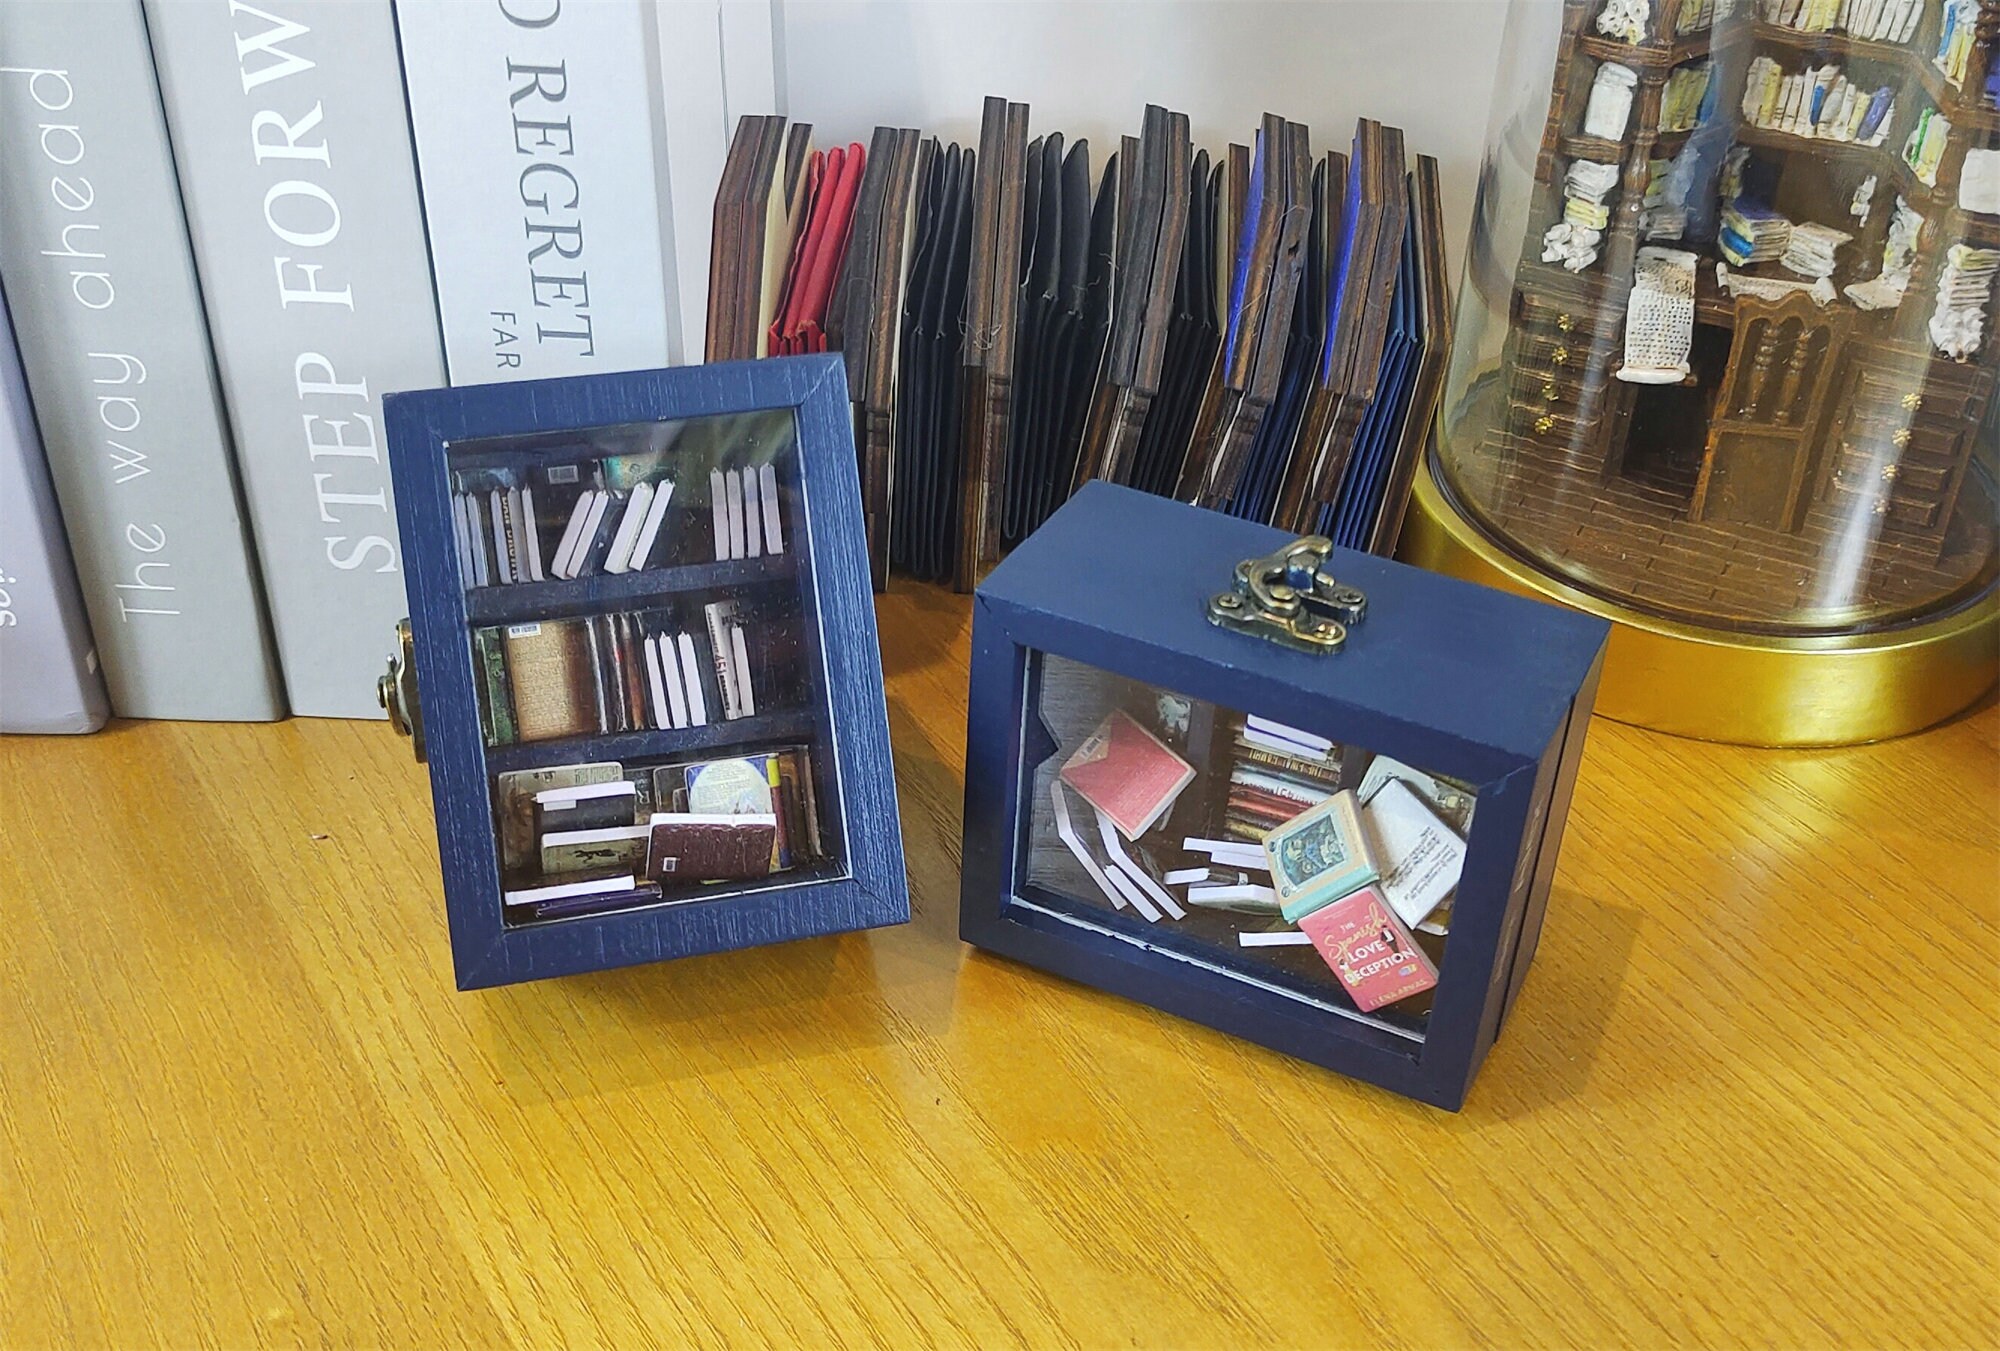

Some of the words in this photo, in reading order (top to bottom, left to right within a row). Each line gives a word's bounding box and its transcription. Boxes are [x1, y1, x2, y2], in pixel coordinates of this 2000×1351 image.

[0, 66, 115, 310] ahead
[505, 56, 595, 358] REGRET
[489, 311, 522, 370] FAR
[87, 351, 151, 485] way
[294, 351, 399, 574] STEP
[113, 521, 181, 624] The
[1343, 946, 1419, 985] DECEPTION
[1348, 938, 1386, 964] LOVE
